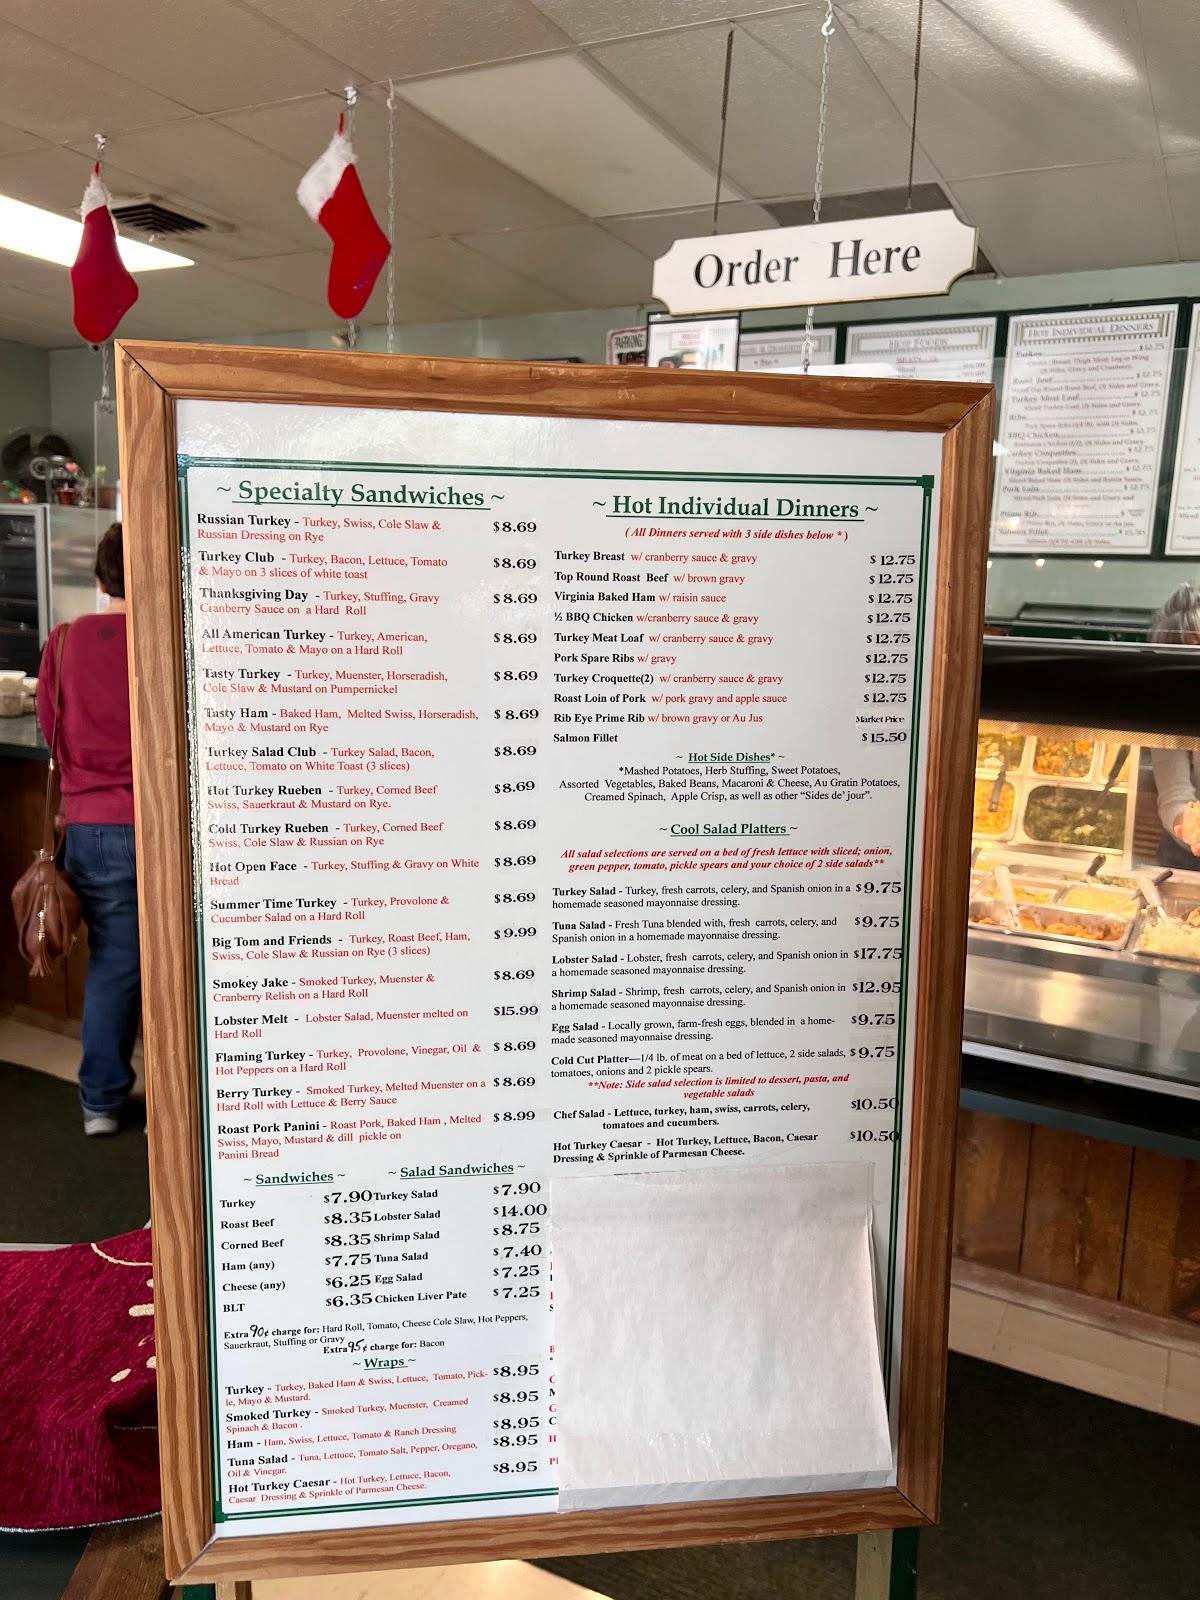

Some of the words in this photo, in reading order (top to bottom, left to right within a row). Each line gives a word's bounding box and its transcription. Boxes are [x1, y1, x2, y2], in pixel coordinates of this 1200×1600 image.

[694, 249, 799, 289] Order
[828, 238, 921, 279] Here
[1109, 322, 1155, 333] DINNERS
[238, 480, 345, 506] Specialty
[350, 484, 485, 506] Sandwiches
[612, 495, 652, 513] Hot
[658, 496, 768, 515] Individual
[776, 498, 858, 517] Dinners
[197, 513, 244, 524] Russian
[247, 514, 290, 528] Turkey
[305, 517, 340, 529] Turkey,
[343, 518, 375, 528] Swiss,
[378, 519, 401, 528] Cole
[405, 520, 428, 529] Slaw
[431, 521, 440, 529] &
[493, 521, 536, 532] $8.69
[197, 529, 237, 539] Russian
[241, 530, 285, 542] Dressing
[304, 531, 323, 543] Rye
[553, 550, 590, 562] Turkey
[593, 551, 625, 560] Breast
[630, 552, 642, 560] w/
[644, 553, 688, 563] cranberry
[719, 553, 728, 562] &
[731, 555, 756, 564] gravy
[566, 612, 589, 623] BBQ
[592, 612, 633, 621] Chicken
[636, 613, 691, 624] w/cranberry
[721, 613, 729, 622] &
[733, 616, 758, 624] gravy
[554, 653, 578, 661] Pork
[580, 653, 609, 664] Spare
[612, 653, 634, 662] Ribs
[651, 656, 676, 664] gravy
[553, 733, 589, 742] Salmon
[593, 733, 617, 741] Fillet
[688, 752, 709, 761] Hot
[710, 752, 732, 761] Side
[662, 766, 702, 775] Potatoes,
[705, 765, 727, 774] Herb
[729, 765, 768, 776] Stuffing,
[771, 765, 798, 774] Sweet
[800, 765, 840, 774] Potatoes,
[208, 823, 236, 833] Cold
[239, 823, 281, 835] Turkey
[285, 823, 328, 832] Rueben
[343, 823, 379, 833] Turkey,
[382, 822, 417, 831] Corned
[420, 822, 444, 830] Beef
[670, 823, 699, 834] Cool
[703, 823, 736, 833] Salad
[741, 823, 786, 833] Platters
[568, 864, 595, 872] green
[596, 863, 631, 872] pepper,
[633, 862, 667, 870] tomato,
[669, 860, 697, 871] pickle
[699, 862, 728, 870] spears
[731, 861, 748, 870] and
[749, 862, 772, 870] your
[773, 859, 803, 868] choice
[805, 859, 816, 869] of
[817, 860, 823, 868] 2
[825, 859, 843, 868] side
[212, 951, 243, 960] Swiss,
[246, 950, 269, 959] Cole
[272, 949, 296, 958] Slaw
[298, 949, 308, 958] &
[311, 948, 349, 957] Russian
[367, 947, 385, 957] Rye
[387, 946, 397, 957] (3
[400, 946, 430, 955] slices)
[493, 1005, 538, 1015] $15.99
[683, 1089, 725, 1099] vegetable
[726, 1088, 754, 1096] salads
[602, 1121, 644, 1129] tomatoes
[646, 1119, 664, 1127] and
[666, 1118, 719, 1126] cucumbers.
[400, 1165, 434, 1177] Salad
[439, 1163, 514, 1175] Sandwiches
[255, 1171, 333, 1182] Sandwiches
[323, 1190, 372, 1203] $7.90
[373, 1191, 408, 1200] Turkey
[411, 1189, 437, 1198] Salad
[219, 1199, 255, 1208] Turkey
[324, 1211, 371, 1224] $8.35
[374, 1212, 411, 1221] Lobster
[413, 1210, 440, 1218] Salad
[252, 1218, 274, 1227] Beef
[373, 1233, 410, 1242] Shrimp
[413, 1230, 439, 1239] Salad
[221, 1240, 258, 1249] Corned
[261, 1238, 284, 1247] Beef
[325, 1253, 371, 1266] $7.75
[374, 1254, 398, 1262] Tuna
[401, 1252, 428, 1260] Salad
[222, 1262, 245, 1270] Ham
[249, 1260, 274, 1270] (any)
[222, 1283, 257, 1291] Cheese
[259, 1280, 285, 1290] (any)
[325, 1292, 372, 1306] $6.35
[374, 1294, 414, 1303] Chicken
[417, 1292, 443, 1300] Liver
[446, 1291, 466, 1299] Pate
[223, 1303, 245, 1312] BLT
[224, 1331, 249, 1339] Extra
[271, 1328, 302, 1338] charge
[304, 1326, 320, 1334] for:
[363, 1358, 405, 1368] Wraps
[493, 1364, 539, 1376] $8.95
[225, 1411, 269, 1421] Smoked
[272, 1408, 310, 1418] Turkey
[261, 1490, 297, 1501] Dressing
[308, 1488, 342, 1499] Sprinkle
